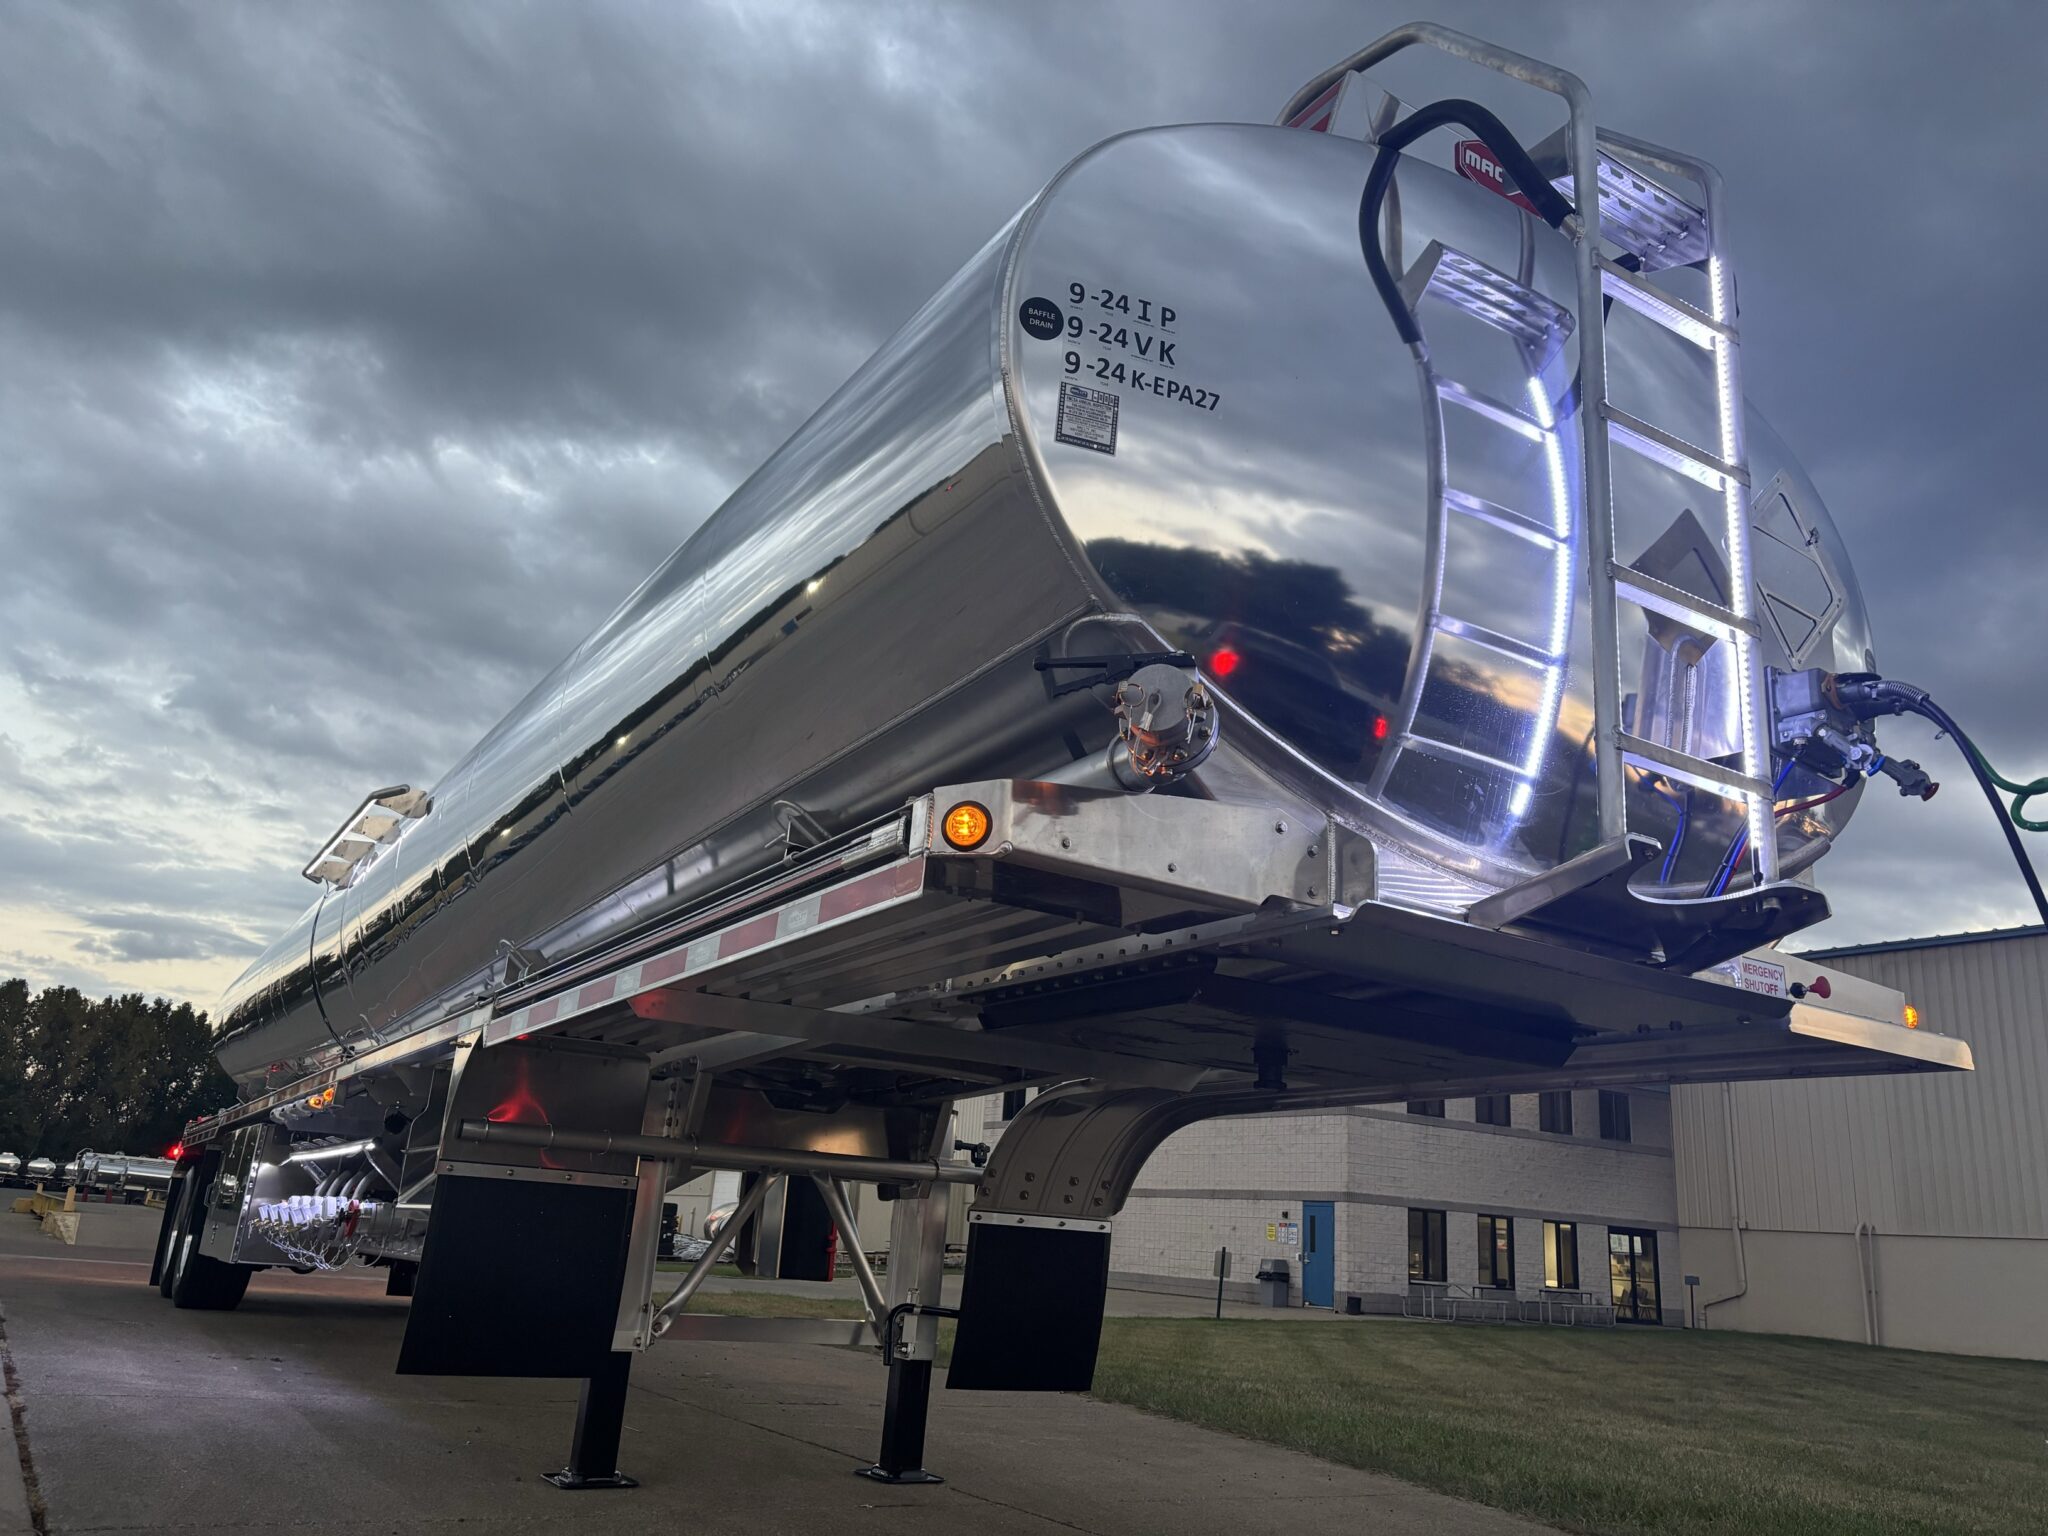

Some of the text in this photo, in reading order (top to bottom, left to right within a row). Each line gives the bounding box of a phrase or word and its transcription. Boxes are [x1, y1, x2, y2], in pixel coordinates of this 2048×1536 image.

[1028, 307, 1056, 320] BAFFLE
[1029, 317, 1054, 329] DRAIN
[1131, 370, 1220, 411] K-EPA27
[1742, 962, 1783, 981] MERGENCY
[1744, 978, 1779, 995] SHUTOFF
